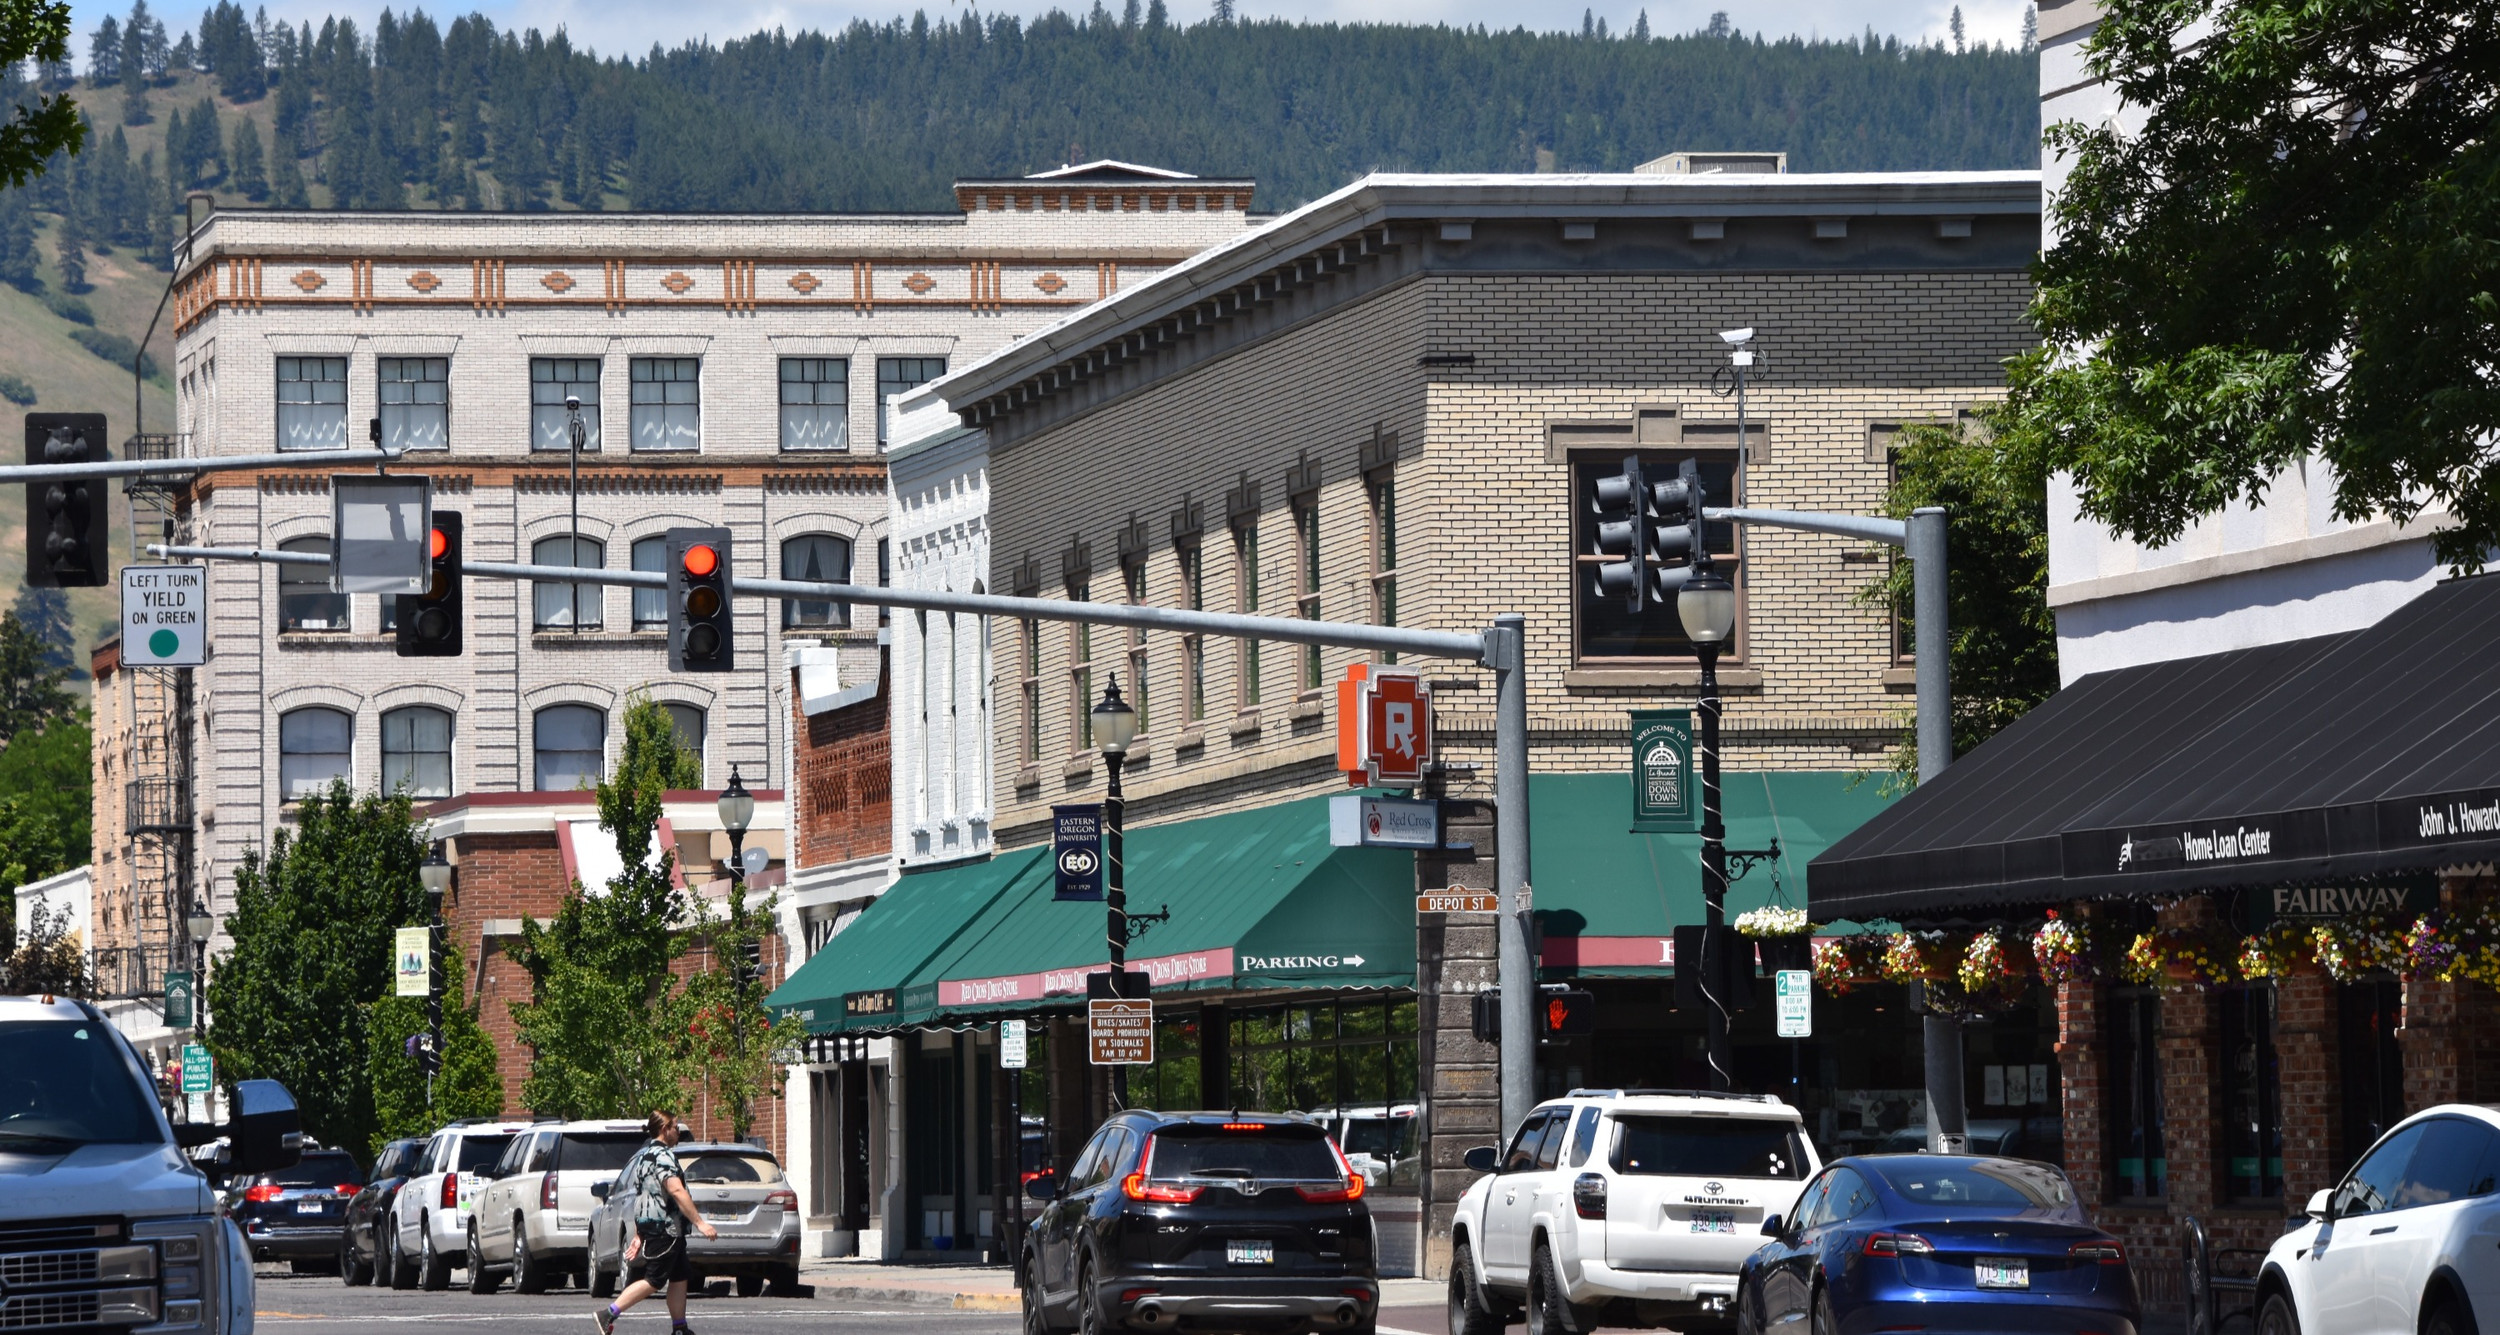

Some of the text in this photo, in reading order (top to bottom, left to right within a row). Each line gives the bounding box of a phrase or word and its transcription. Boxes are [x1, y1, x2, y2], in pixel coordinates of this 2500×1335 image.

[130, 574, 197, 588] LEFT TURN
[143, 592, 186, 607] YIELD
[132, 611, 196, 624] ON GREEN
[1636, 725, 1687, 741] WELCOME TO
[1390, 812, 1432, 829] Red Cross
[2420, 798, 2500, 838] John J. Howard
[2184, 826, 2270, 861] Home Loan Center
[1429, 897, 1485, 910] DEPOT ST
[2273, 888, 2409, 913] FAIRWAY
[1152, 961, 1170, 982] CROSS
[1171, 958, 1188, 980] DRUG
[1188, 956, 1206, 978] STORE
[1241, 956, 1339, 971] PARKING
[1044, 974, 1056, 992] RED
[1056, 972, 1073, 990] CROSS
[1779, 976, 1787, 992] 2
[1788, 985, 1808, 993] PARKING
[961, 980, 1018, 1002] RED CROSS DRUG STORE
[1003, 1024, 1009, 1036] 2
[1097, 1018, 1144, 1027] BIKES/SKATES/
[1092, 1028, 1150, 1037] BOARDS PROHIBITED
[1098, 1039, 1144, 1047] ON SIDEWALKS
[186, 1065, 207, 1073] PUBLIC
[185, 1073, 210, 1081] PARKING
[1978, 1263, 2025, 1279] 715 MPX
